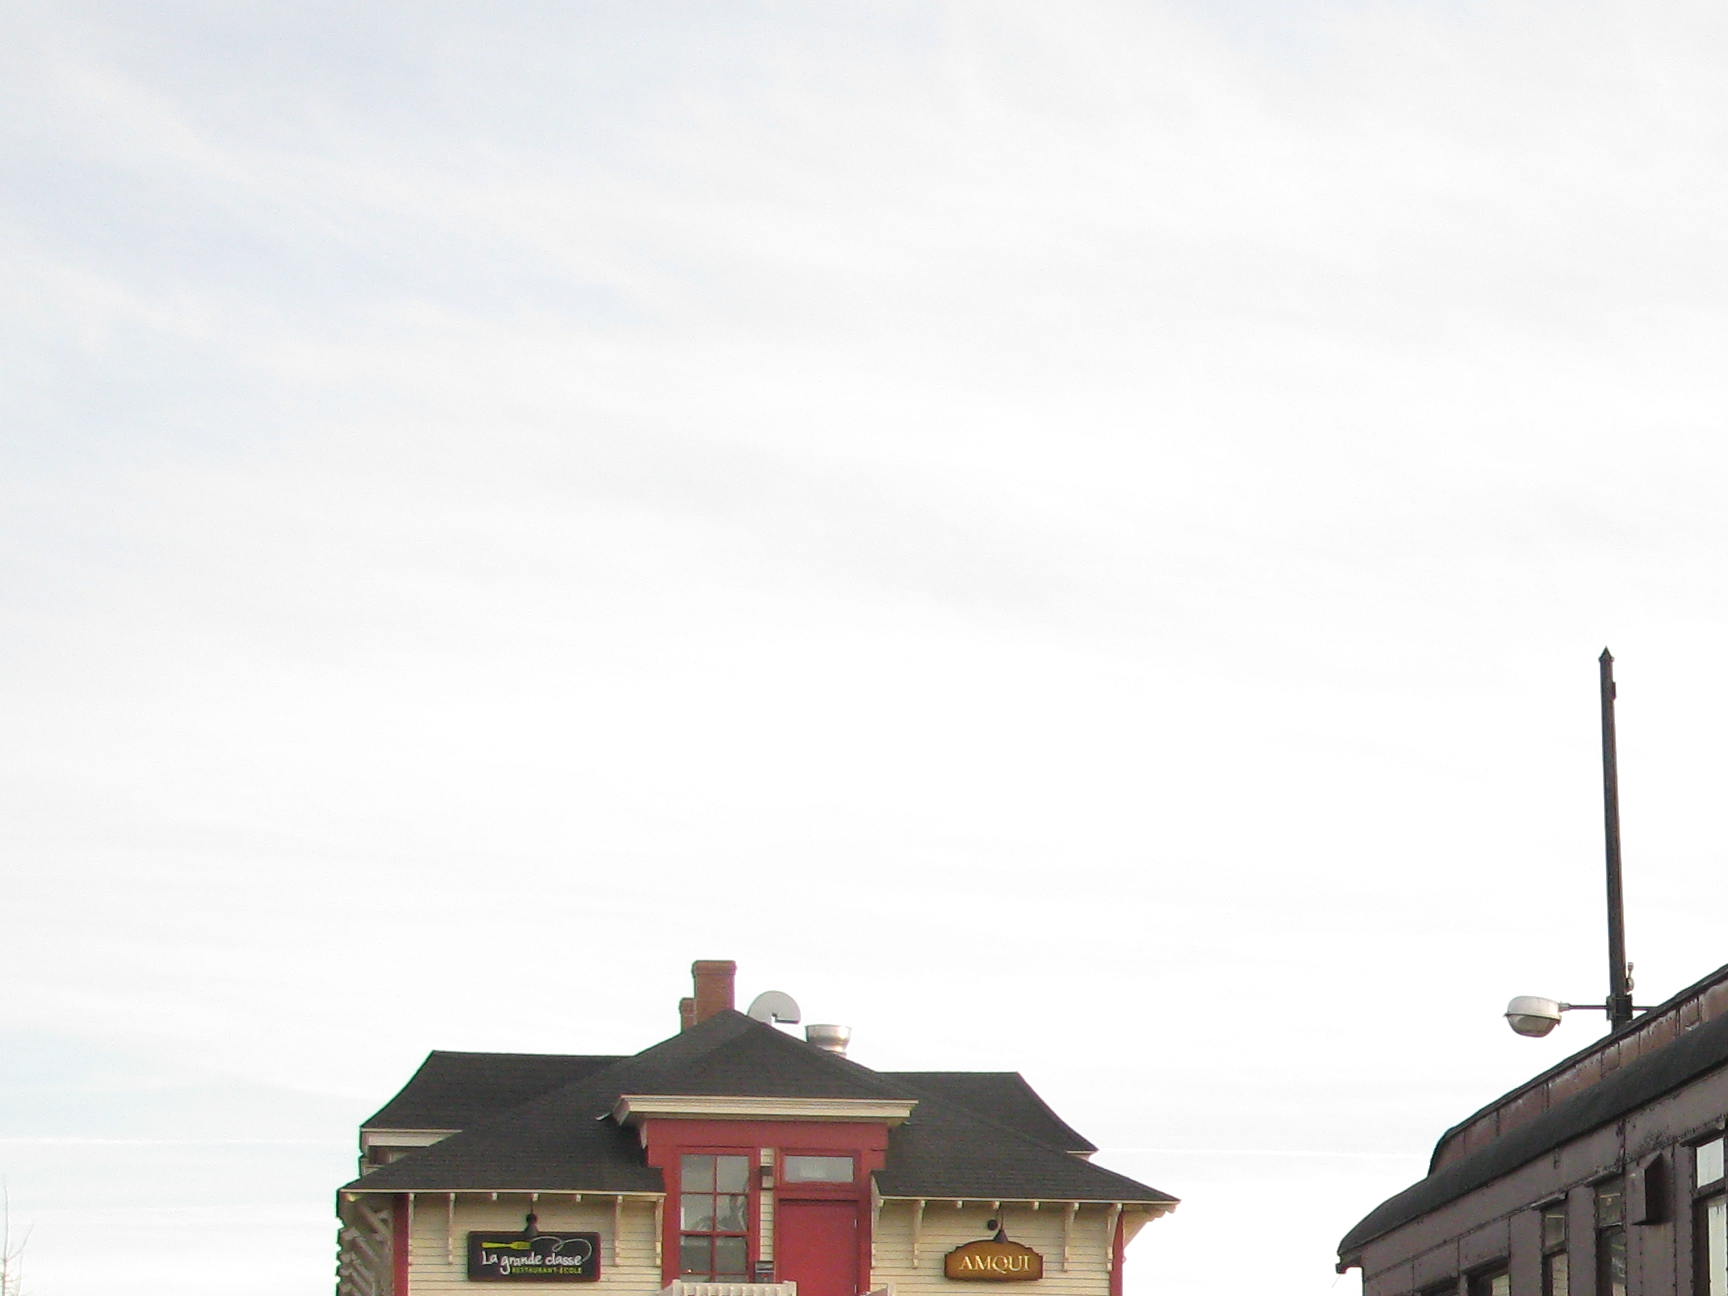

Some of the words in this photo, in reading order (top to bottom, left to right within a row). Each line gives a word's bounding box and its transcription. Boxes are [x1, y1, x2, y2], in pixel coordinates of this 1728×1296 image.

[482, 1250, 498, 1265] La
[500, 1251, 542, 1275] grande
[545, 1252, 582, 1265] classe
[960, 1255, 1030, 1274] AMQUI
